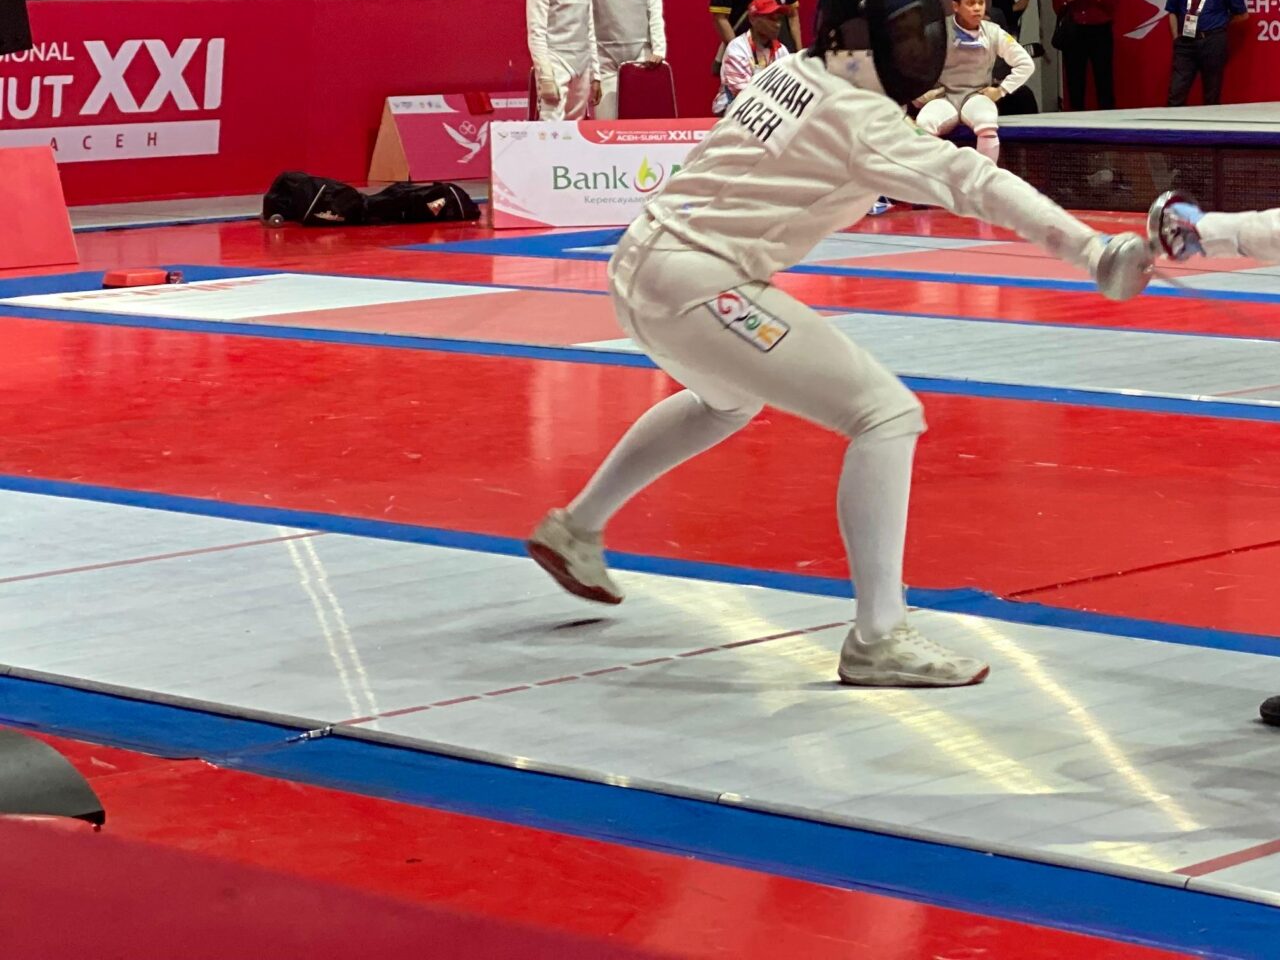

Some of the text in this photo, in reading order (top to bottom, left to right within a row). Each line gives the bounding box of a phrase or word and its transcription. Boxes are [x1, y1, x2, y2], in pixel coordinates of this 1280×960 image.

[0, 42, 75, 62] ONAL
[0, 37, 226, 120] UT XXI
[753, 65, 815, 120] INAYAH
[732, 96, 783, 143] ACEH
[50, 131, 158, 152] ACEH
[667, 129, 693, 141] XXI
[552, 164, 629, 190] Bank
